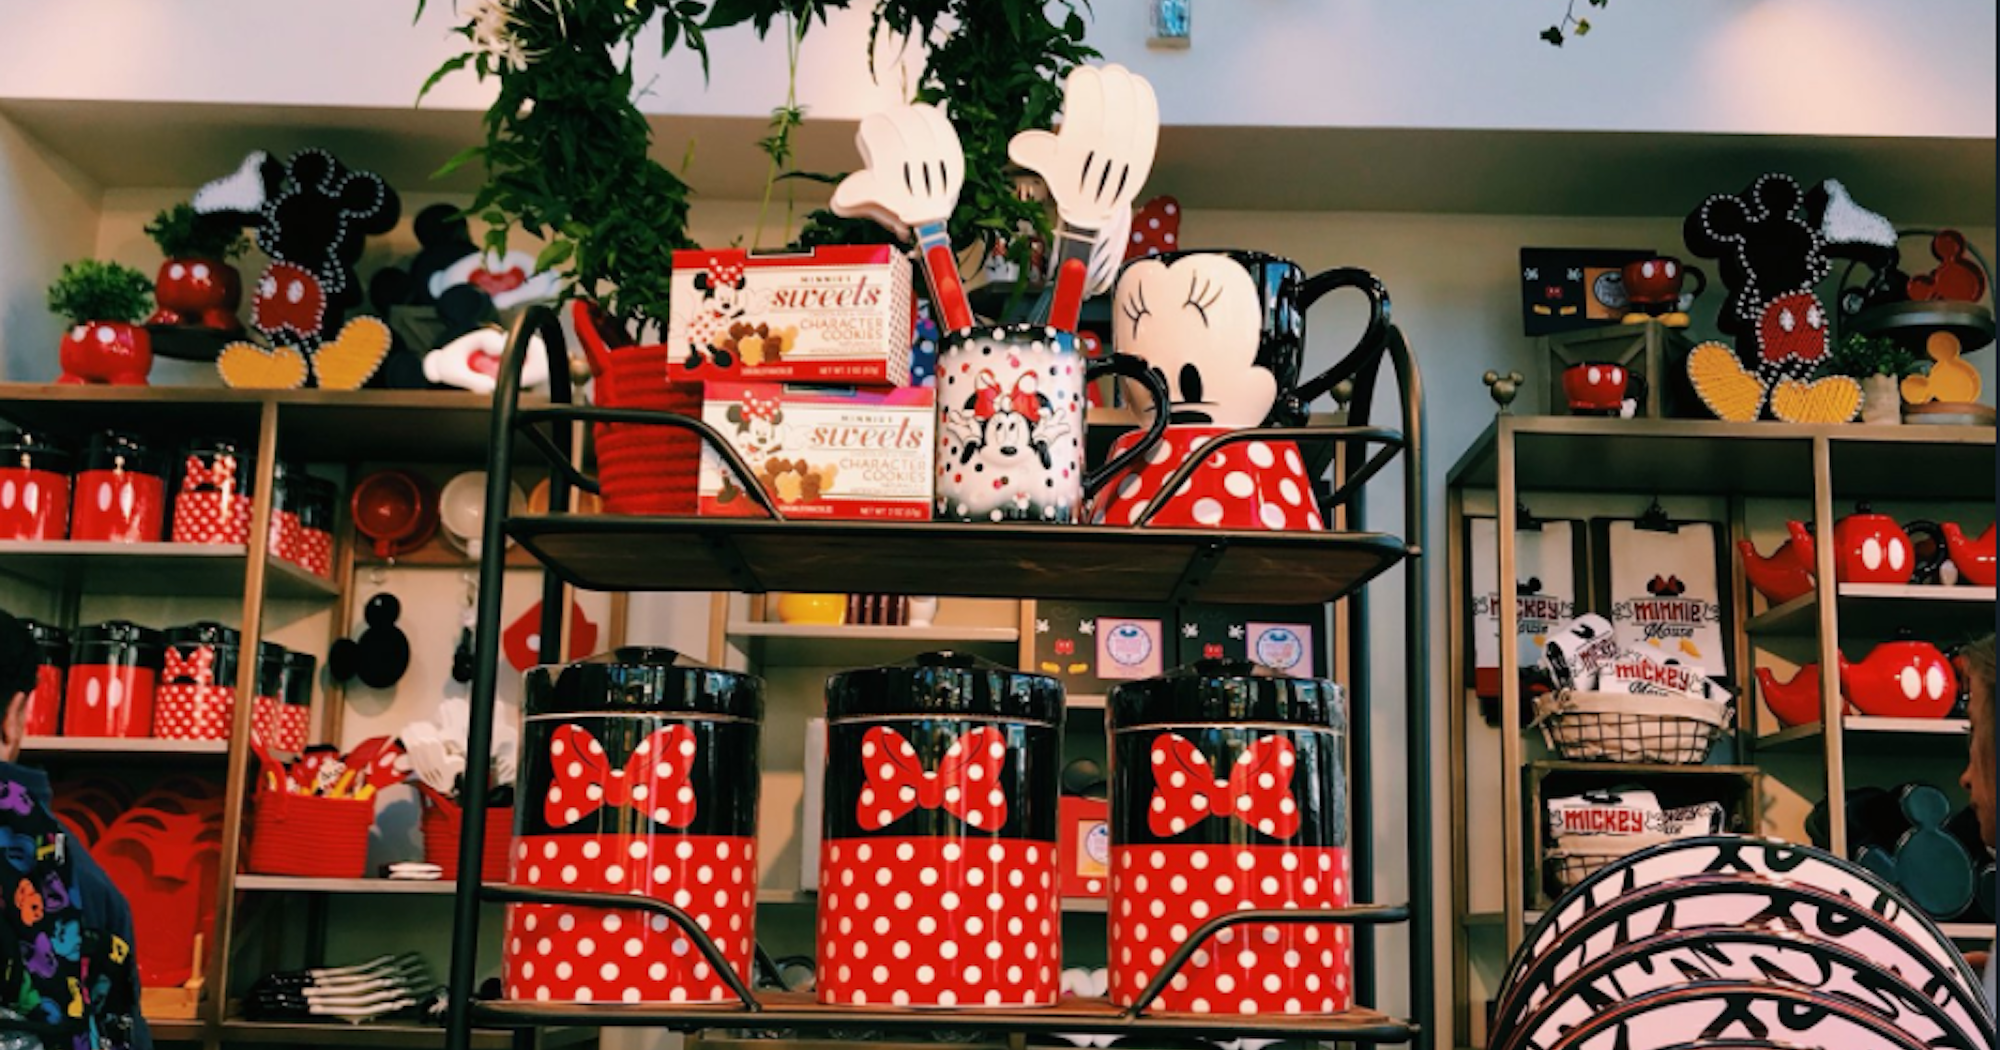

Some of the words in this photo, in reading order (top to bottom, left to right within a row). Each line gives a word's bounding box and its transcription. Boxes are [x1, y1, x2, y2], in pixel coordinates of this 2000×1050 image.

[771, 275, 882, 308] sweets
[799, 317, 883, 331] CHARACTER
[821, 329, 883, 341] COOKIES
[810, 416, 924, 449] sweets
[839, 457, 926, 471] CHARACTER
[862, 469, 926, 483] COOKIES
